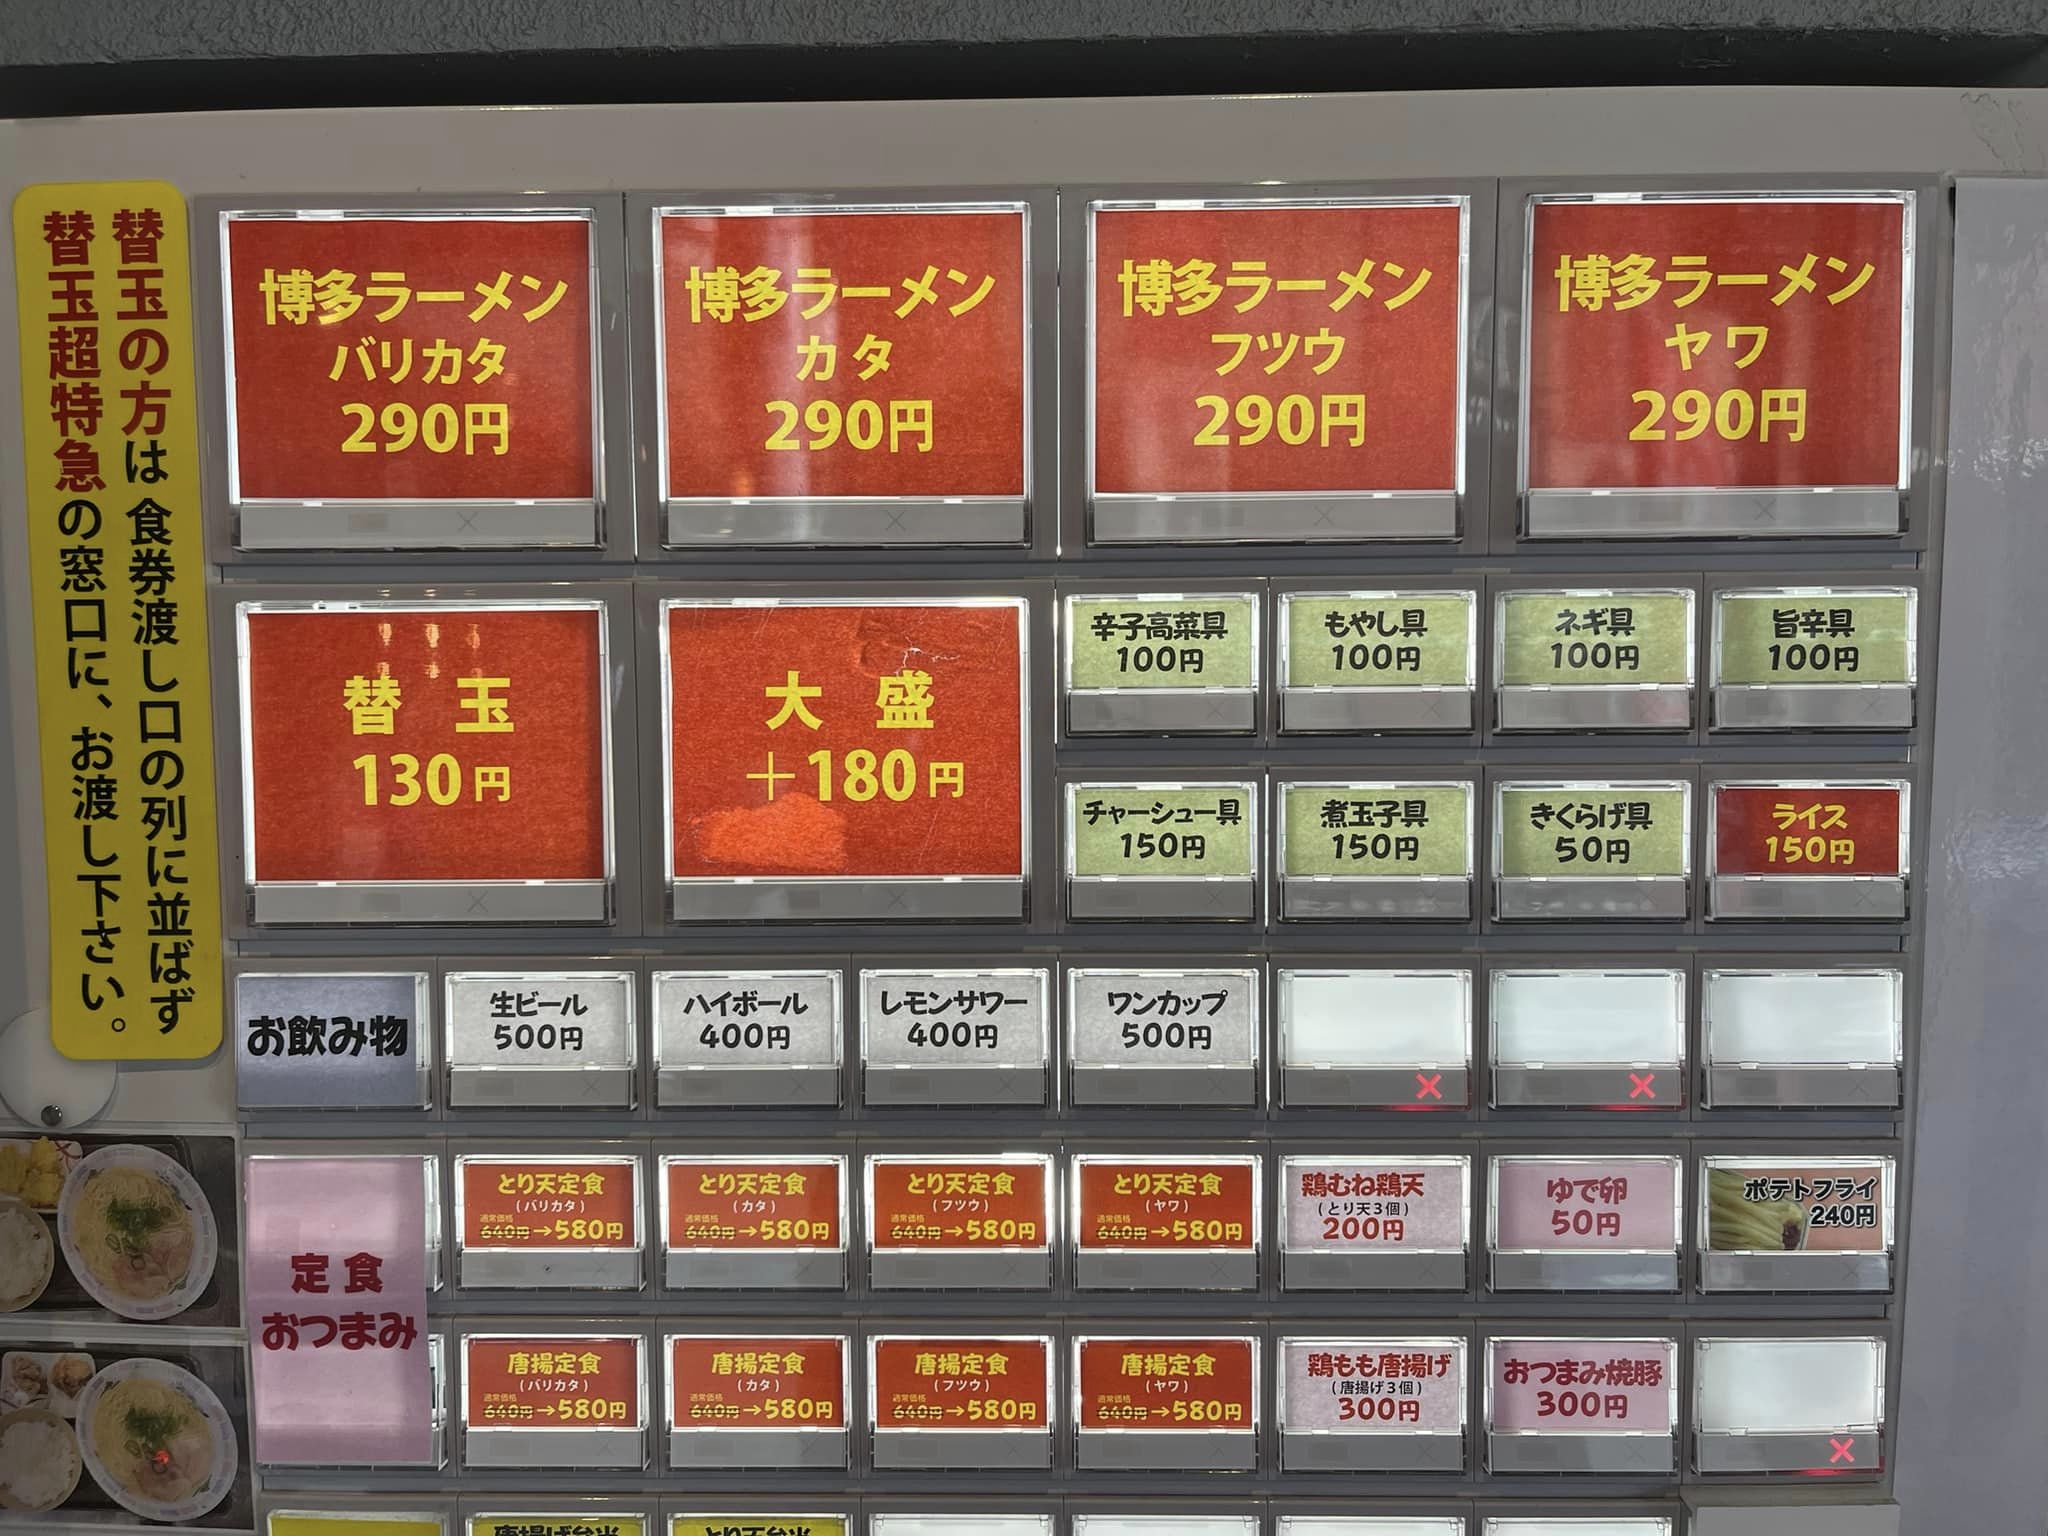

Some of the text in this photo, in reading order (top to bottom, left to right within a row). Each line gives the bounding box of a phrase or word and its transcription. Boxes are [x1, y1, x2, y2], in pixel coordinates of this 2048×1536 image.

[259, 268, 568, 325] 博多ラーメン
[685, 264, 996, 324] 博多ラーメン
[1117, 257, 1433, 317] 博多ラーメン
[1554, 252, 1875, 313] 博多ラーメン
[329, 336, 508, 385] バリカタ
[796, 333, 893, 382] カタ
[1211, 326, 1346, 376] フツウ
[1665, 322, 1769, 371] ヤワ
[341, 402, 509, 455] 290円
[764, 398, 933, 453] 290円
[1194, 394, 1366, 447] 290円
[1628, 388, 1807, 443] 290円
[1091, 611, 1228, 641] 辛子高菜具
[1324, 609, 1428, 637] もやし具
[1555, 607, 1635, 636] ネギ具
[1772, 608, 1855, 638] 旨辛具
[1117, 646, 1204, 673] 100円
[1332, 644, 1420, 671] 100円
[1550, 642, 1639, 671] 100円
[1768, 643, 1859, 672] 100円
[352, 753, 511, 806] 130円
[1083, 798, 1242, 826] チャーシュー具
[1320, 799, 1429, 828] 煮玉子具
[1530, 802, 1653, 830] きくらげ具
[1772, 803, 1848, 830] ライス
[1120, 832, 1205, 860] 150円
[1332, 833, 1419, 861] 150円
[1554, 836, 1631, 864] 50円
[1766, 836, 1855, 865] 150円
[489, 990, 588, 1018] 生ビール
[683, 990, 808, 1017] ハイボール
[880, 989, 1028, 1017] レモンサワー
[1107, 989, 1228, 1017] ワンカップ
[247, 1015, 408, 1057] お飲み物
[493, 1023, 583, 1051] 500円
[699, 1022, 791, 1049] 400円
[906, 1022, 999, 1049] 400円
[1121, 1022, 1212, 1050] 500円
[498, 1172, 605, 1197] とり天定食
[699, 1172, 806, 1197] とり天定食
[907, 1172, 1015, 1196] とり天定食
[1113, 1172, 1223, 1197] とり天定食
[1301, 1172, 1425, 1198] 鶏むね鶏天
[1547, 1176, 1627, 1204] ゆで卵
[1744, 1176, 1878, 1201] ポテトフライ
[1322, 1217, 1404, 1241] 200円
[1551, 1209, 1621, 1237] 50円
[1810, 1205, 1875, 1226] 240円
[554, 1219, 624, 1241] 580円
[759, 1219, 829, 1241] 580円
[966, 1219, 1036, 1241] 580円
[1172, 1219, 1243, 1242] 580円
[262, 1311, 418, 1351] おつまみ
[507, 1351, 602, 1375] 唐揚定食
[711, 1351, 806, 1375] 唐揚定食
[914, 1352, 1009, 1377] 唐揚定食
[1120, 1352, 1216, 1377] 唐揚定食
[1307, 1353, 1452, 1379] 鶏もも唐揚げ
[1503, 1358, 1663, 1387] おつまみ焼豚
[557, 1398, 627, 1420] 580円
[763, 1398, 833, 1420] 580円
[967, 1399, 1037, 1421] 580円
[1172, 1399, 1242, 1421] 580円
[1338, 1398, 1420, 1422] 300円
[1536, 1391, 1628, 1419] 300円
